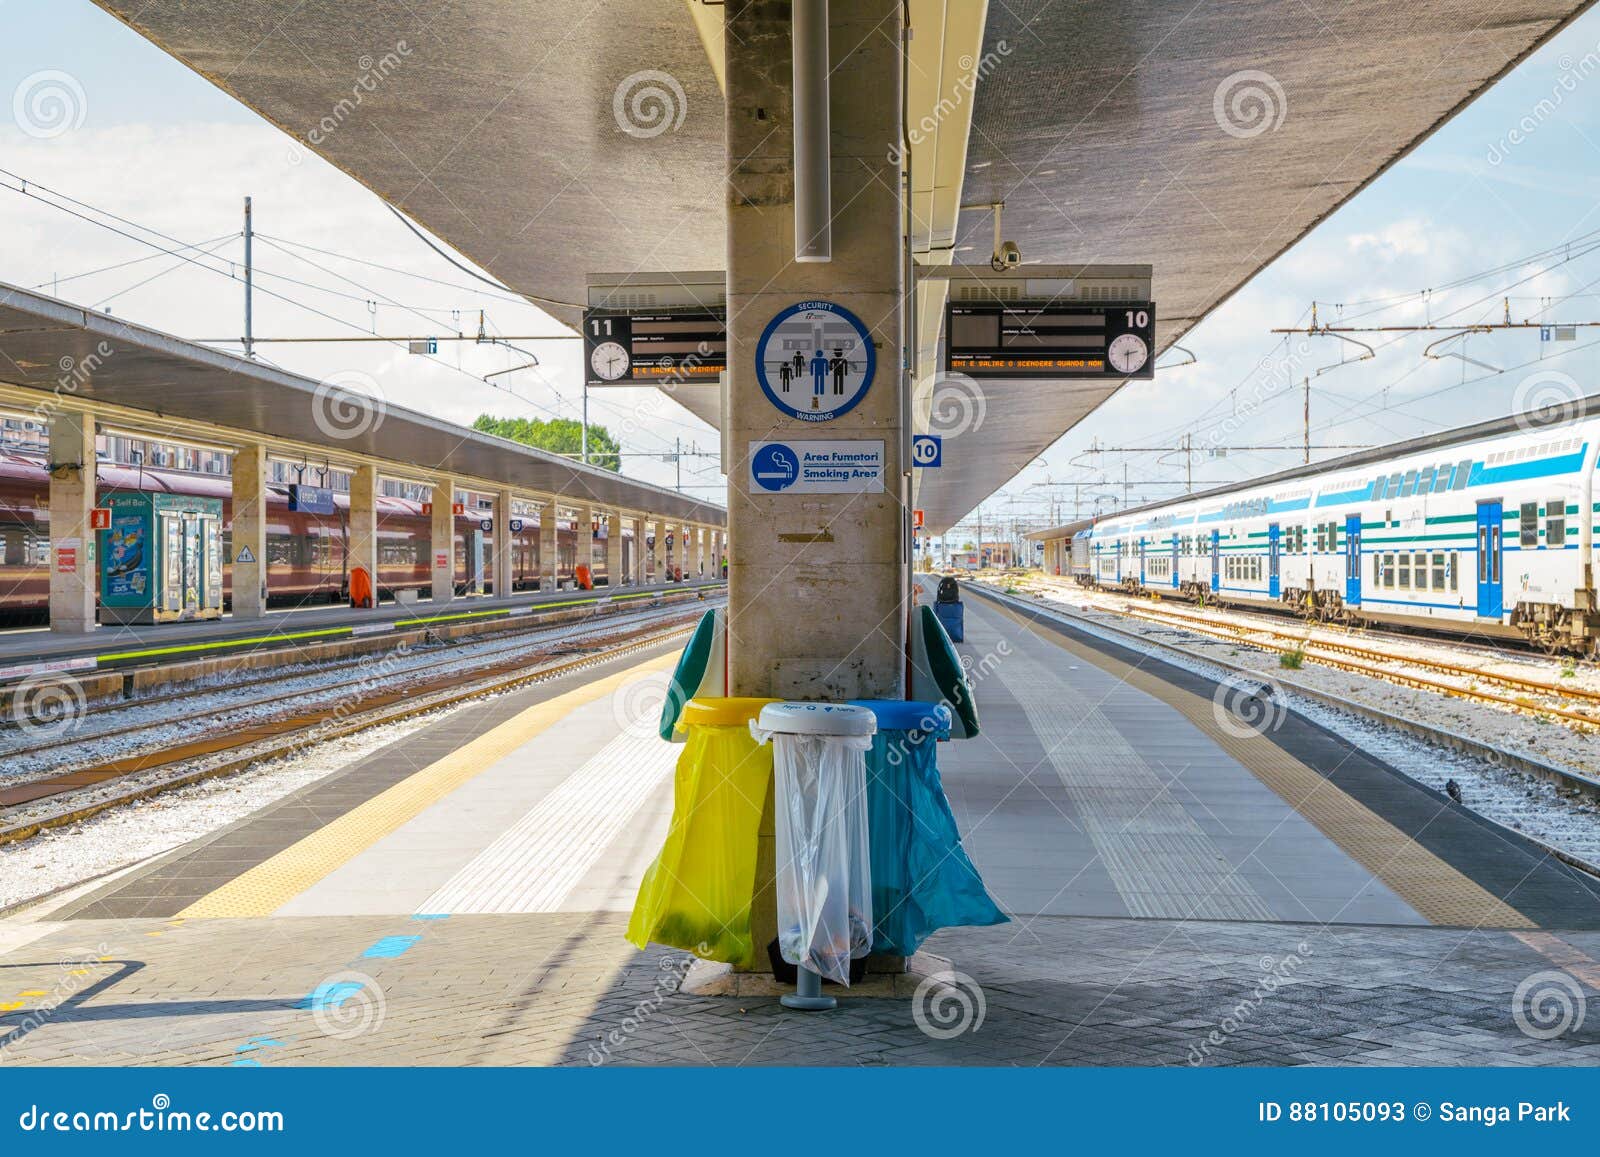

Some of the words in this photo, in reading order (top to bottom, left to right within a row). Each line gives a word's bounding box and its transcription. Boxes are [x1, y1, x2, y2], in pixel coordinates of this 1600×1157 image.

[798, 303, 834, 311] SECURITY
[1125, 311, 1148, 328] 10
[591, 320, 612, 336] 11
[796, 412, 834, 421] WARNING
[804, 452, 829, 461] Area
[832, 452, 879, 461] Fumatori
[916, 444, 935, 458] 10
[804, 469, 849, 480] Smoking
[852, 469, 877, 478] Area
